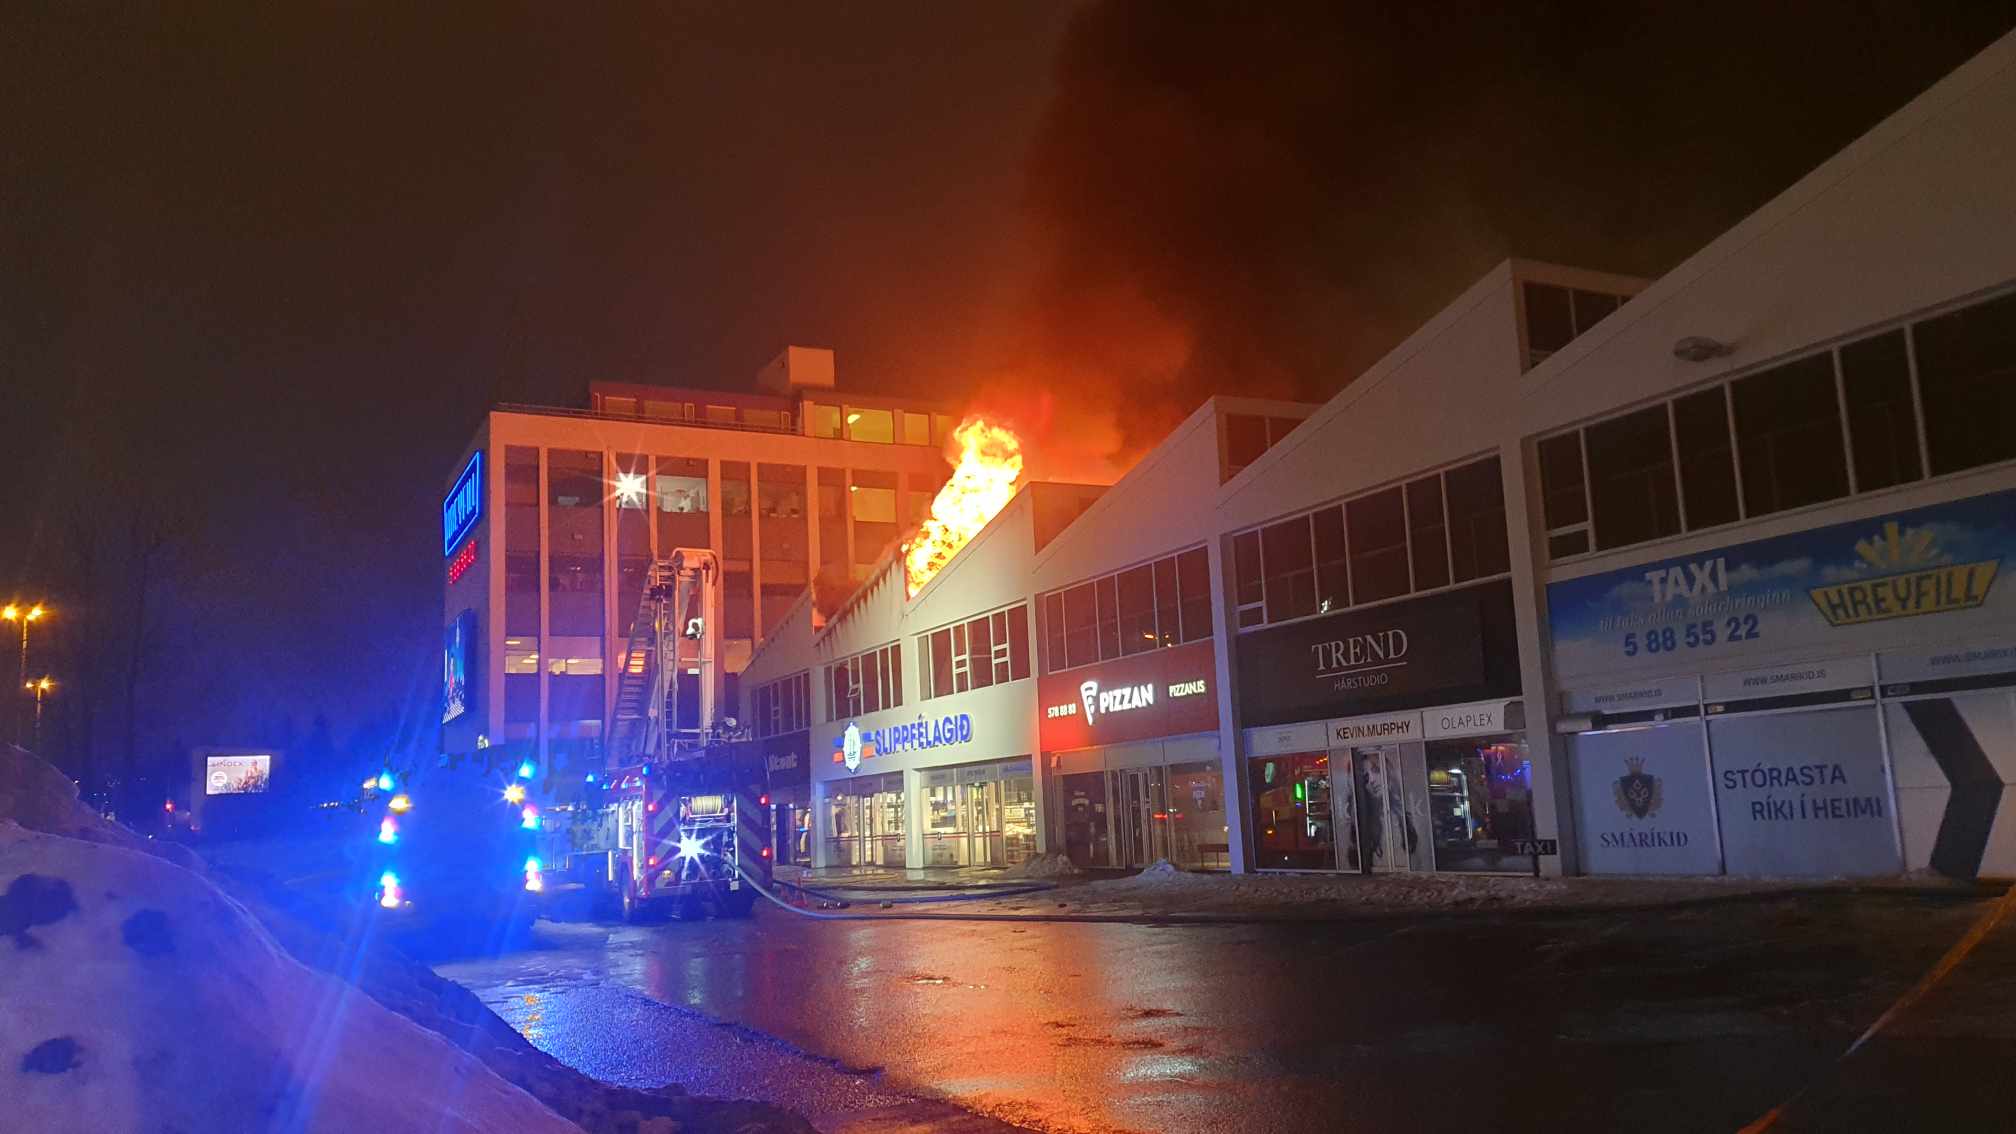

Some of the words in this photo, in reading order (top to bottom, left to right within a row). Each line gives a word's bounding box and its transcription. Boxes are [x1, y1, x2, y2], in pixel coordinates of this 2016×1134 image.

[1646, 557, 1728, 603] TAXI
[1823, 566, 1980, 619] HREYFILL
[1624, 632, 1638, 657] 5
[1646, 627, 1677, 653] 88
[1685, 619, 1716, 648] 55
[1725, 613, 1760, 642] 22
[1312, 629, 1408, 670] TREND
[1099, 684, 1154, 713] PIZZAN
[1168, 680, 1206, 697] PIZZAN.IS
[875, 713, 972, 756] SLIPPFÉLAGIÐ
[1336, 719, 1411, 740] KEVIN.MURPHY
[1441, 711, 1493, 730] OLAPLEX
[1723, 763, 1847, 789] STÓRASTA
[1751, 794, 1794, 821] RÍKI
[1800, 793, 1807, 819] Í
[1811, 796, 1884, 819] HEIMI
[1513, 841, 1552, 855] TAXI
